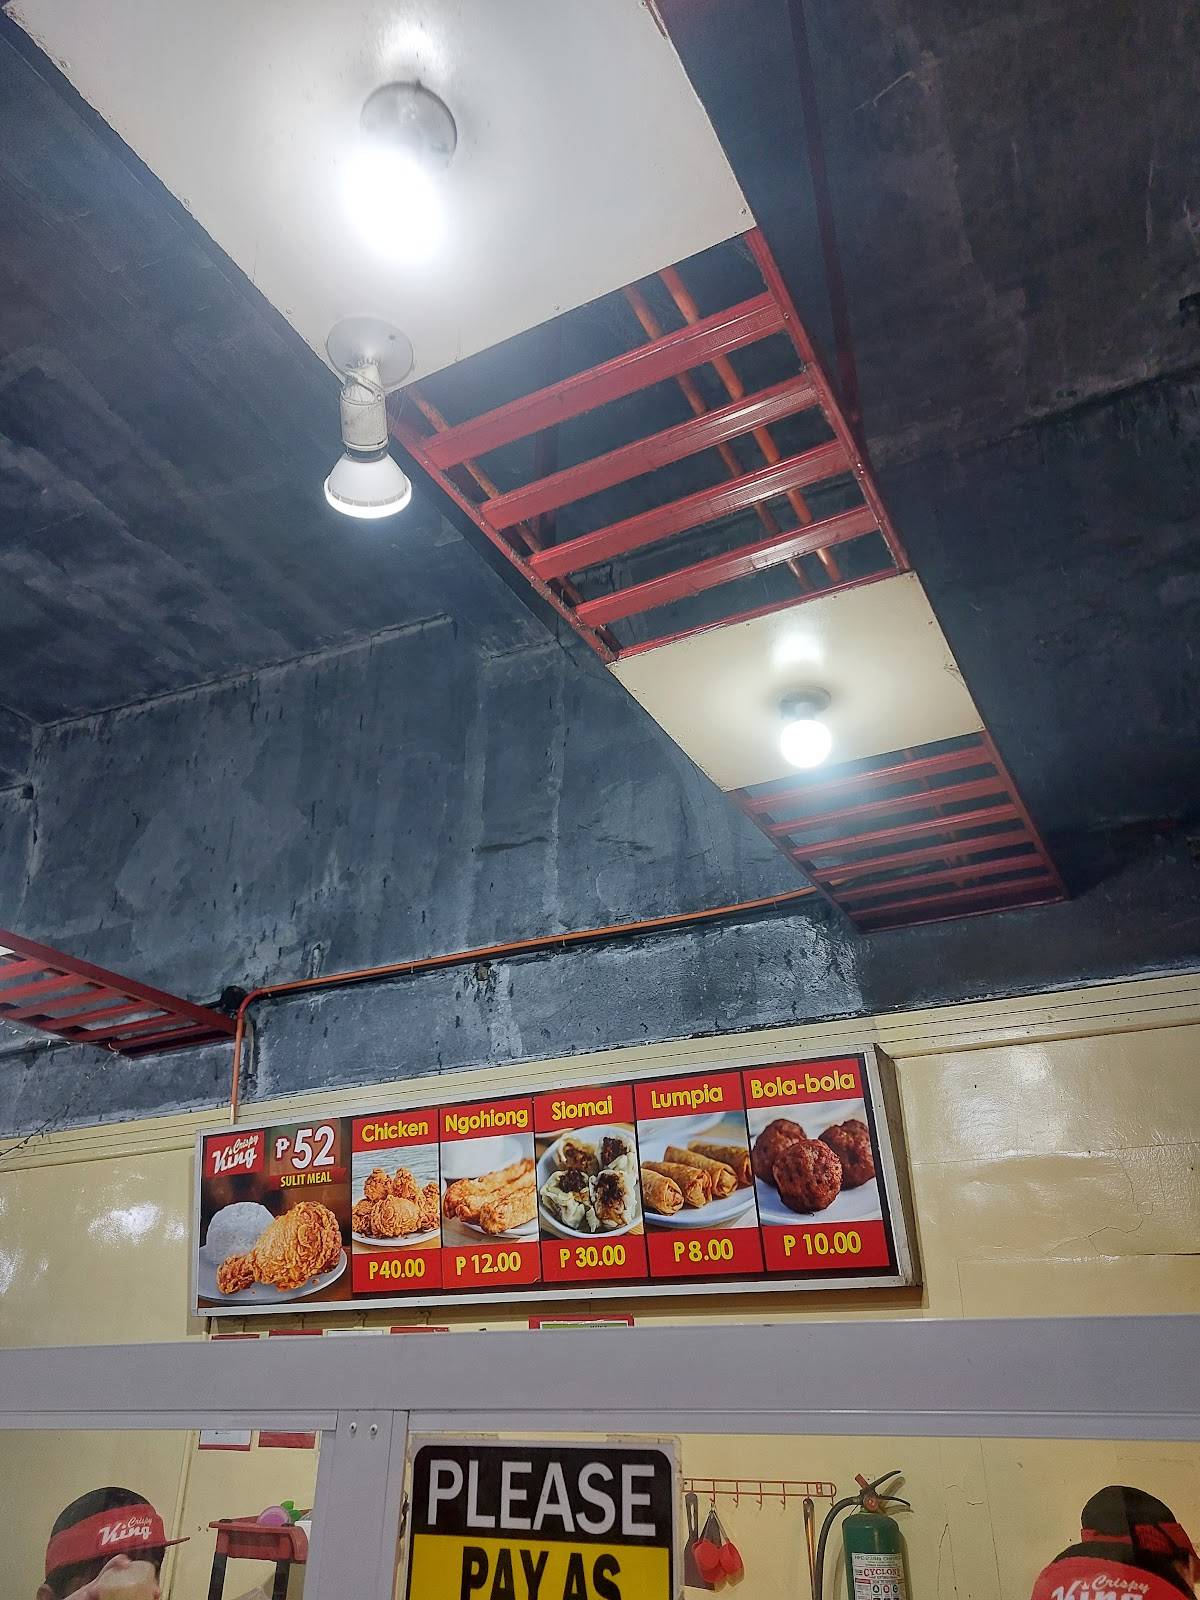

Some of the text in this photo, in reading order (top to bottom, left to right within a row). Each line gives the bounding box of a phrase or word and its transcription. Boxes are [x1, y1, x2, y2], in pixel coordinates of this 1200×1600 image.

[651, 1083, 723, 1109] Lumpia
[750, 1070, 856, 1099] Bola-bola
[551, 1095, 613, 1121] Siomai
[361, 1121, 429, 1143] Chicken
[445, 1109, 529, 1135] Ngohiong
[211, 1145, 258, 1174] King
[280, 1171, 332, 1188] SULIT MEAL
[427, 1459, 656, 1537] PLEASE
[98, 1522, 153, 1546] King
[460, 1546, 622, 1600] PAY AS
[1091, 1574, 1150, 1594] Crispy
